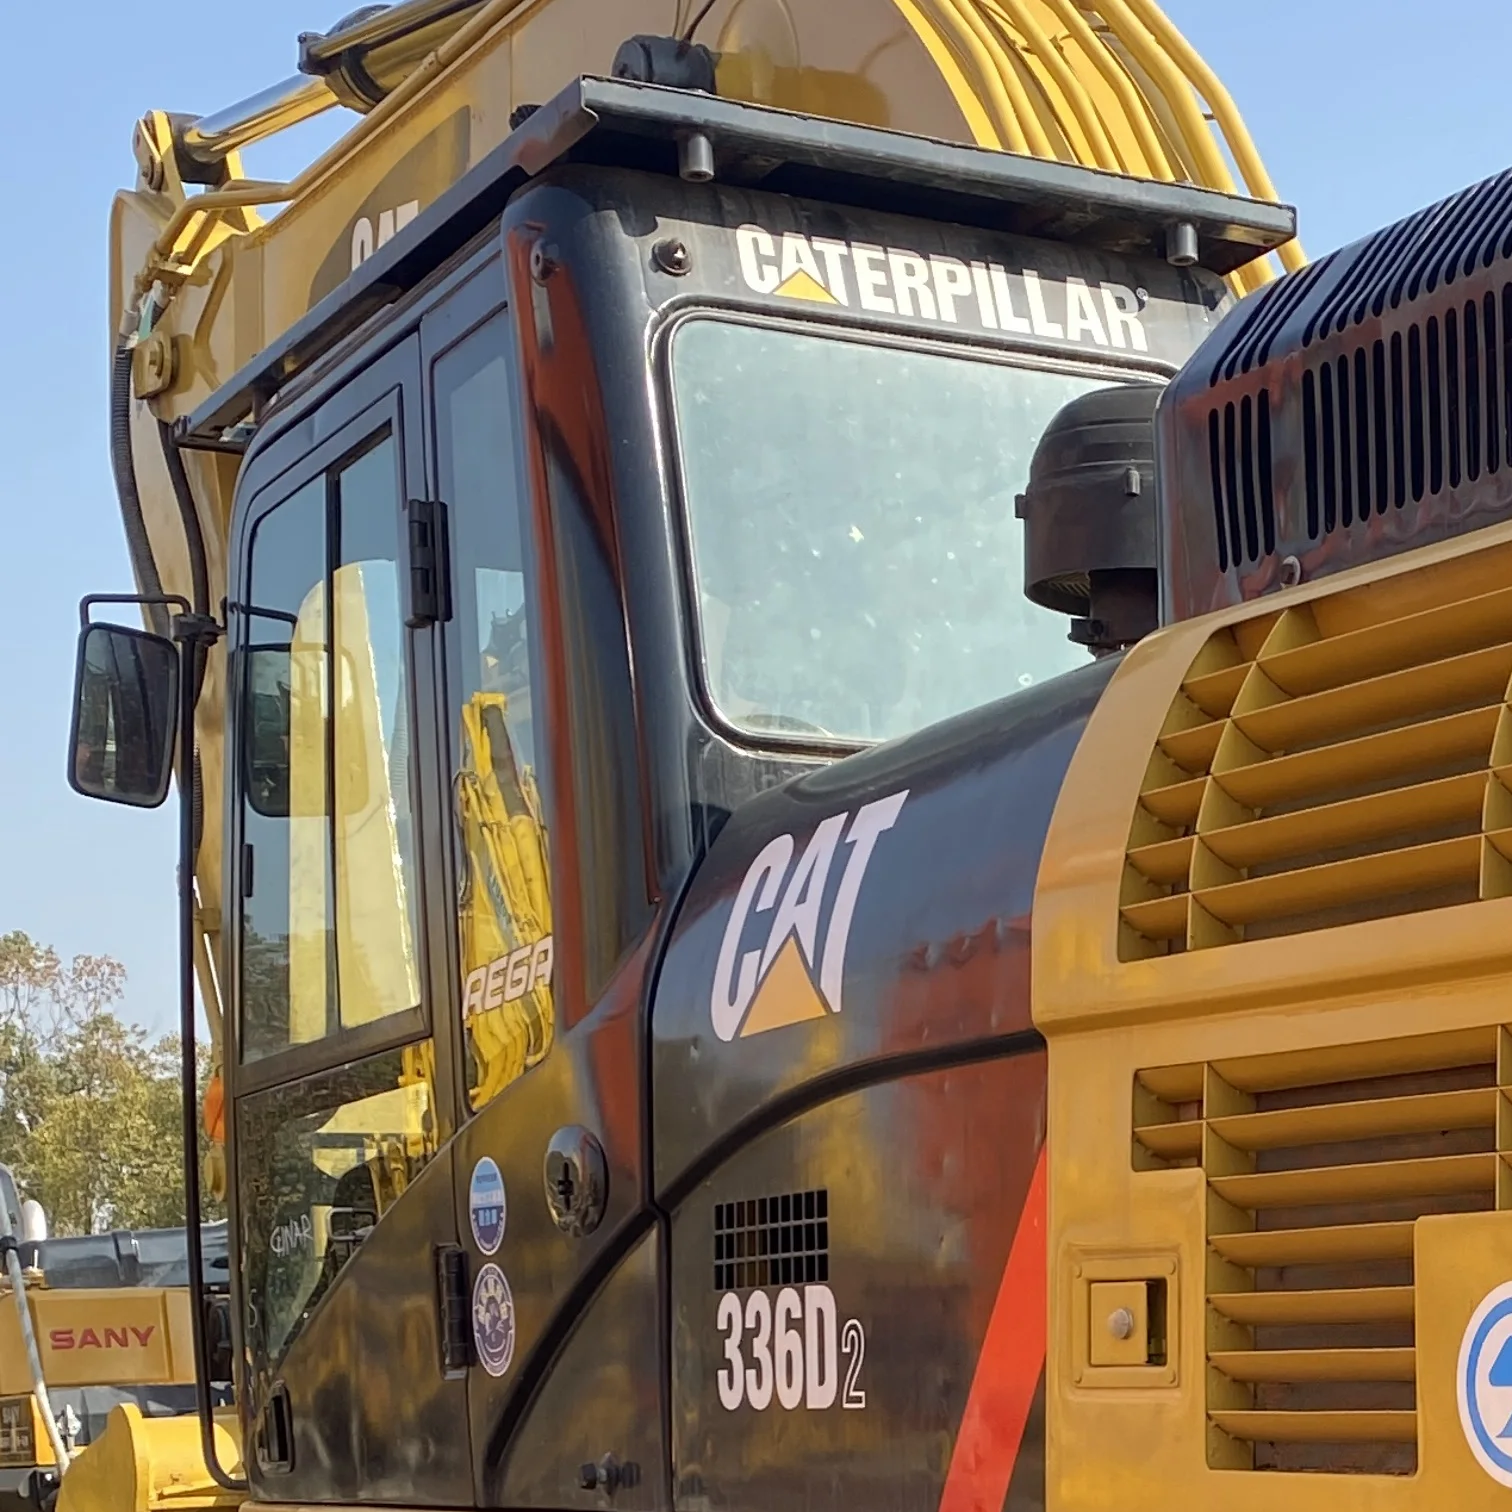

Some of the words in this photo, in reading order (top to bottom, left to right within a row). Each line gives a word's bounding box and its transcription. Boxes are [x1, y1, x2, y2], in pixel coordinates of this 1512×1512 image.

[736, 223, 1148, 352] CATERPILLAR
[711, 789, 909, 1042] CAT
[50, 1325, 155, 1350] SANY
